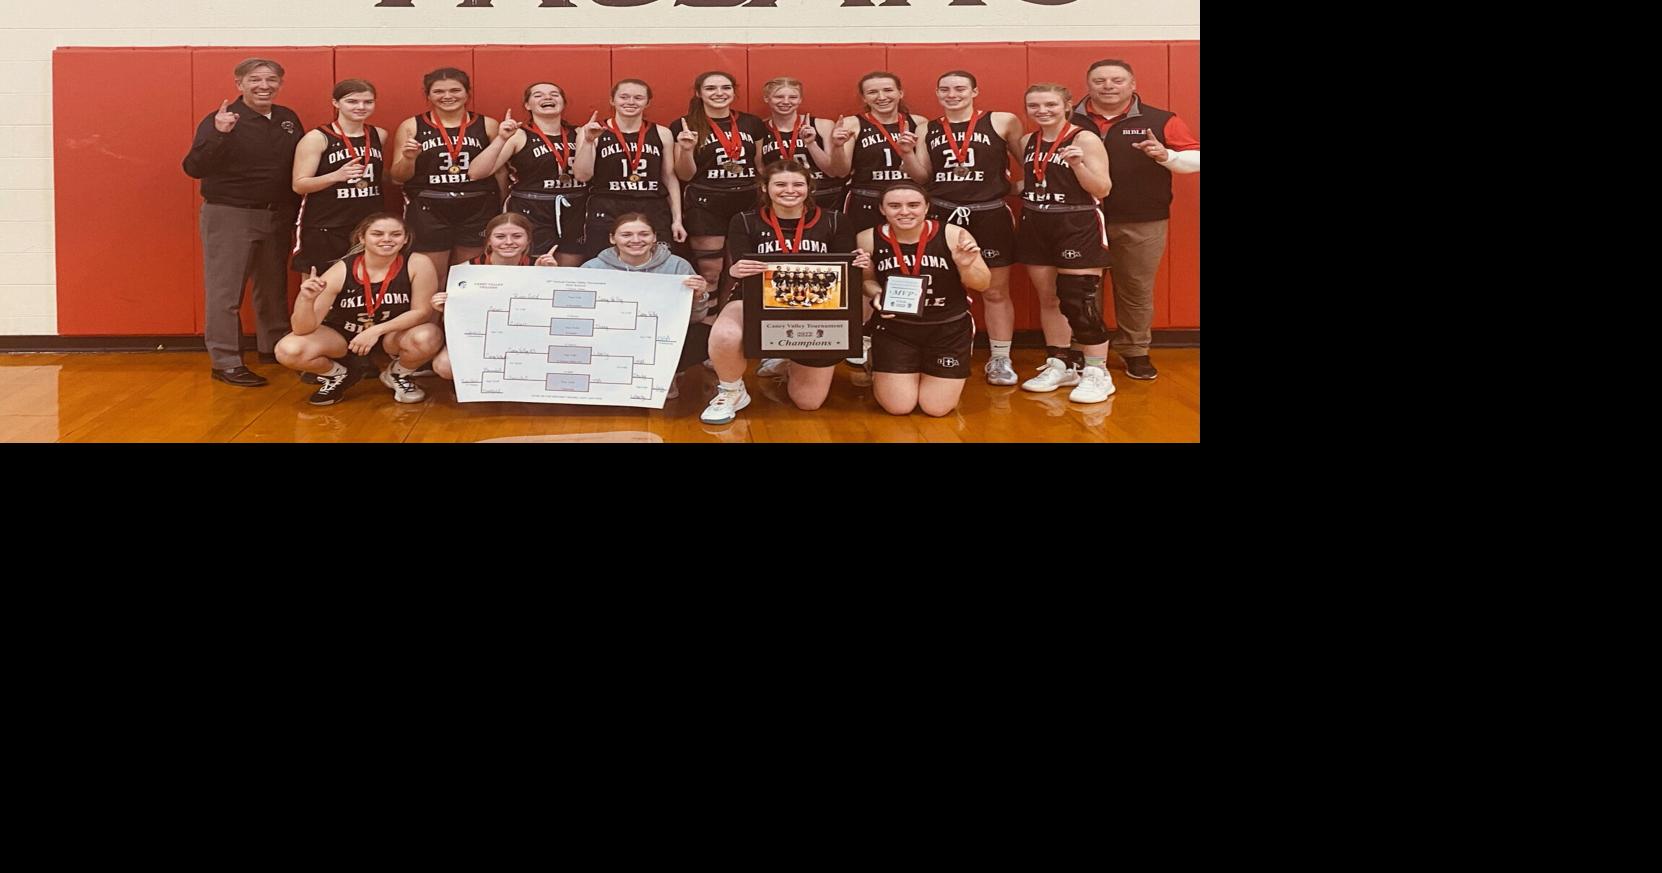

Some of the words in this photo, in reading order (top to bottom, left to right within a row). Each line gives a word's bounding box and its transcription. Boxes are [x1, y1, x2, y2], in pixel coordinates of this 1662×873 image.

[930, 131, 991, 150] OKLHMA
[438, 151, 470, 171] 33
[942, 147, 975, 169] 20
[621, 158, 648, 177] 12
[429, 174, 475, 184] BIBL
[872, 170, 912, 181] BIBL
[543, 178, 587, 189] BIBL
[609, 181, 659, 191] BIBLE
[336, 185, 381, 199] BIBLE
[778, 339, 832, 348] Champions
